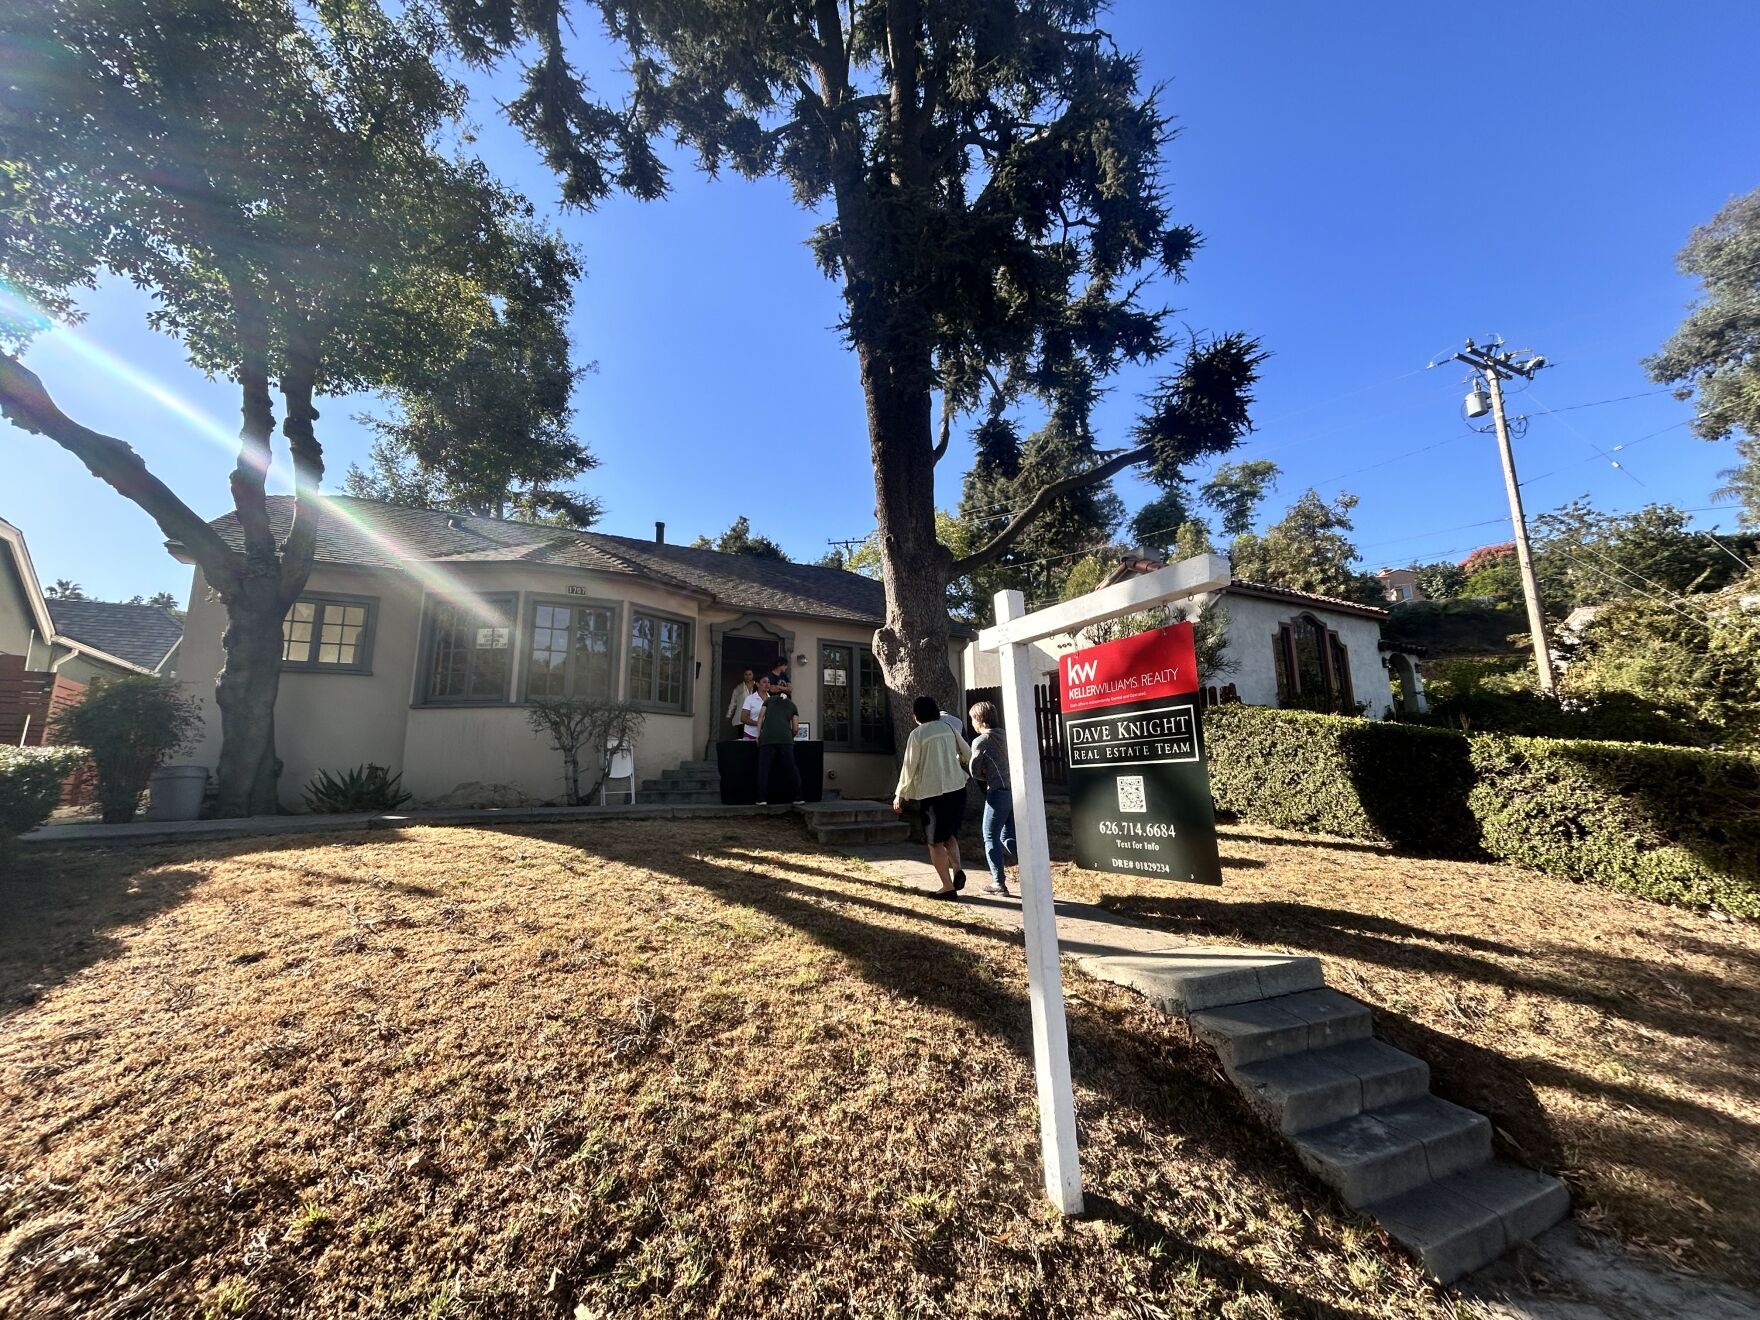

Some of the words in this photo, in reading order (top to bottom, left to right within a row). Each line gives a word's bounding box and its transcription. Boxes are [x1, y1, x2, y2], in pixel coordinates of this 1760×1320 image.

[1067, 657, 1098, 686] kw
[1141, 667, 1179, 687] REALTY
[1074, 749, 1100, 760] REAL
[1105, 746, 1150, 758] ESTATE
[1155, 741, 1190, 755] TEAM
[1099, 821, 1176, 838] 626.714.6684
[1116, 839, 1131, 849] Text
[1132, 841, 1142, 850] for
[1144, 841, 1160, 851] Info
[1111, 858, 1134, 869] DRE#
[1135, 861, 1170, 874] 01829234
